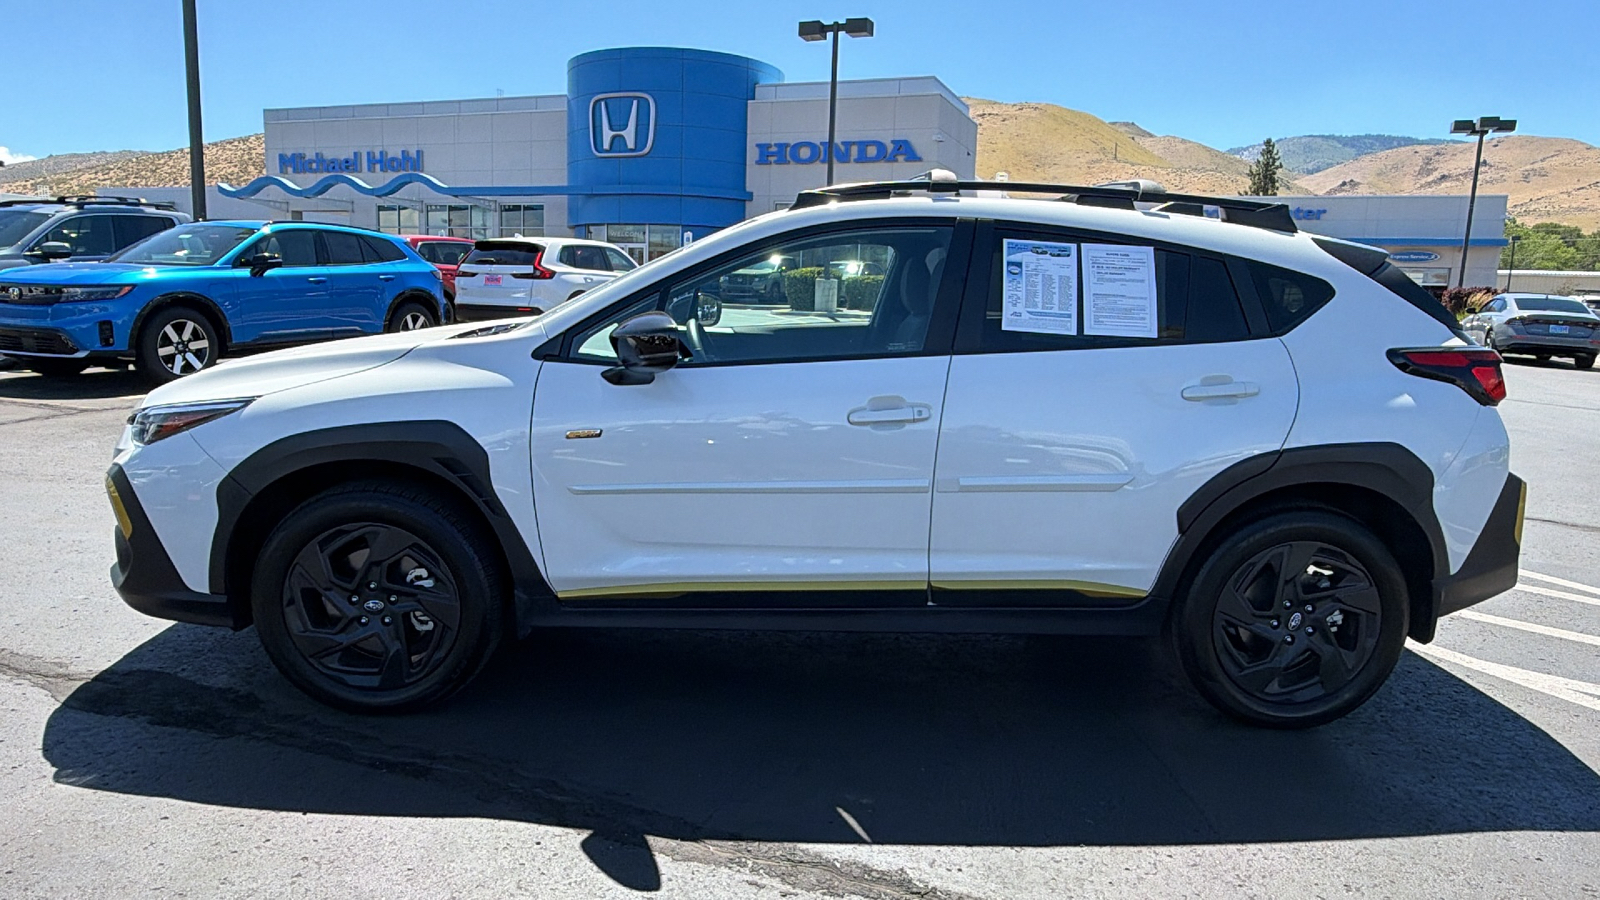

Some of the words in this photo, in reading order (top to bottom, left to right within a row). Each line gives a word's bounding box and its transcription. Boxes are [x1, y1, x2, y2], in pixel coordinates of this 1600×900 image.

[278, 151, 360, 174] Michael
[366, 150, 423, 173] Hohl
[755, 140, 923, 165] HONDA
[1290, 206, 1327, 220] ter
